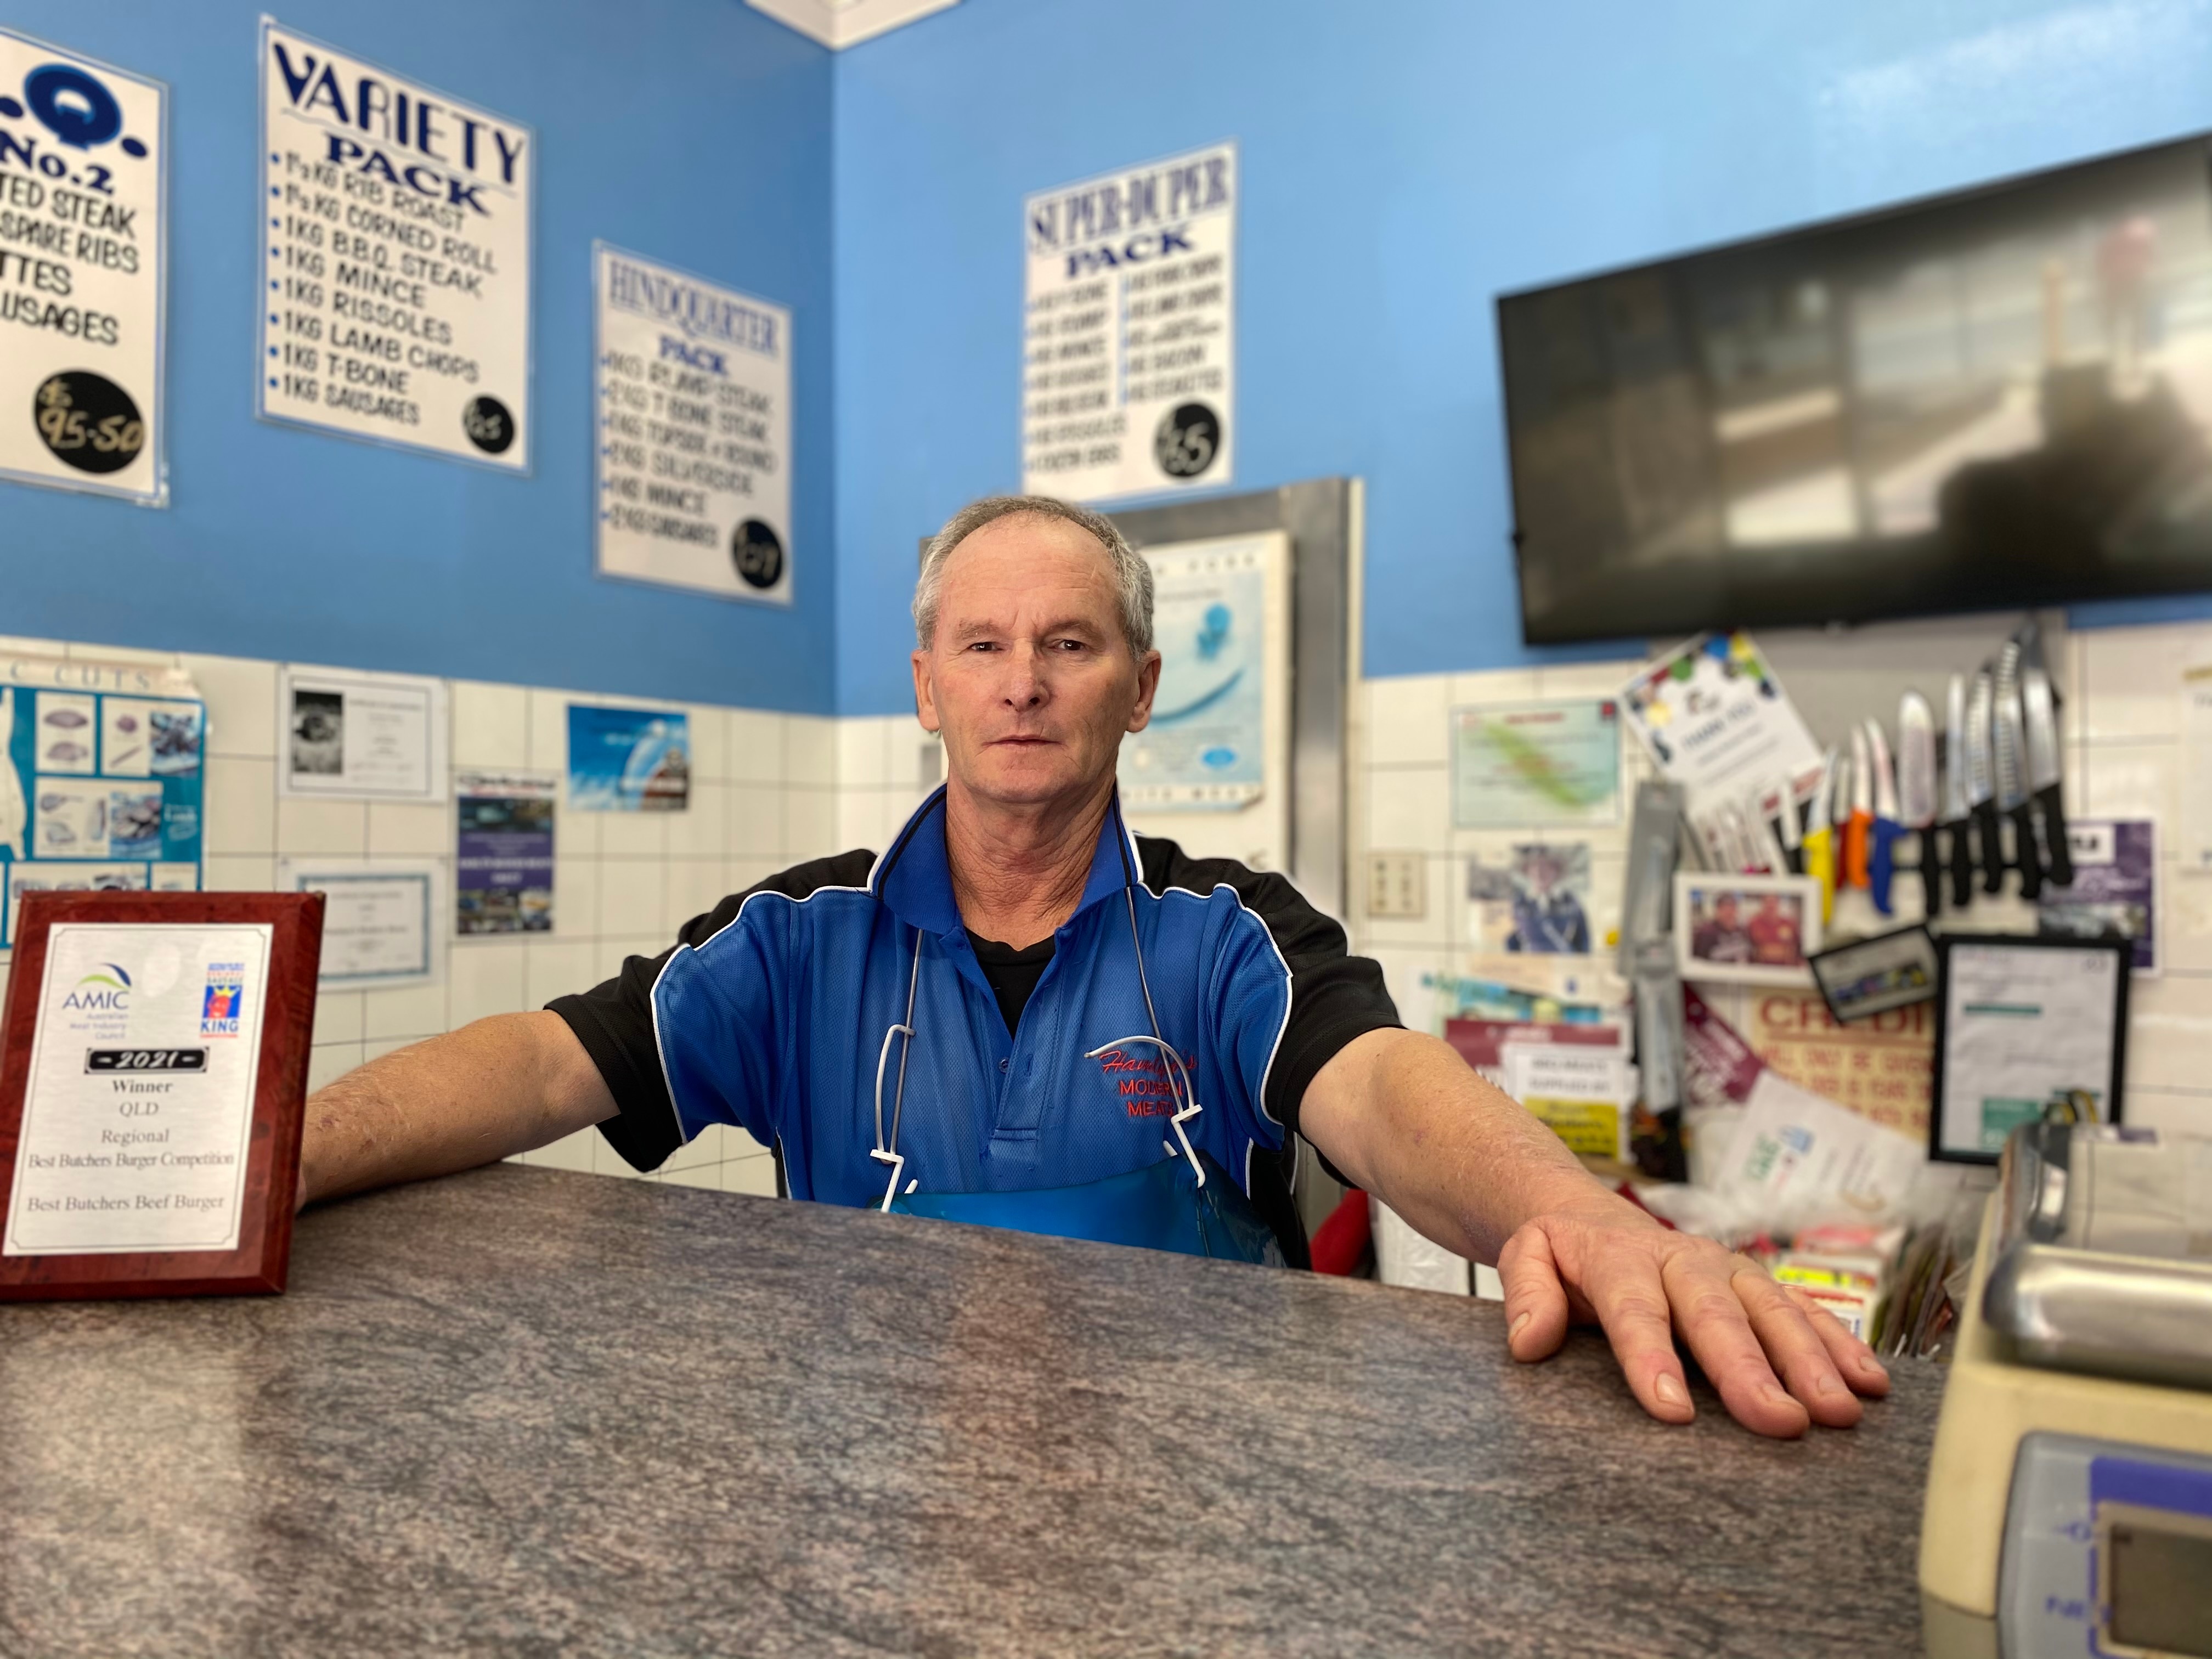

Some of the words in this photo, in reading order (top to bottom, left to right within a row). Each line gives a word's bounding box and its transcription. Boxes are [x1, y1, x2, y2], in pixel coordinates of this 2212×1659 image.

[273, 42, 525, 184] VARIETY
[324, 129, 491, 217] PACK
[53, 187, 136, 240] STEAK
[344, 172, 385, 205] RIB
[393, 190, 464, 232] ROAST
[1, 212, 71, 258] SPARE
[77, 231, 140, 275] RIBS
[286, 216, 323, 247] 1KG
[401, 254, 483, 300] STEAK
[347, 205, 436, 251] CORNED
[442, 236, 497, 274] ROLL
[1065, 228, 1193, 278] PACK
[286, 246, 324, 276] 1KG
[336, 262, 426, 308] MINCE
[2, 291, 120, 347] USAGES
[286, 278, 324, 308] 1KG
[333, 290, 452, 346] RISSOLES
[285, 311, 322, 340] 1KG
[330, 324, 401, 362] LAMB
[408, 346, 479, 384] CHOPS
[285, 343, 318, 373] 1KG
[326, 353, 410, 394] T-BONE
[658, 335, 727, 375] PACK
[285, 375, 318, 403] 1KG
[326, 383, 420, 426] SAUSAGES
[55, 665, 150, 690] CUTS
[62, 991, 128, 1010] AMIC
[200, 1020, 239, 1033] KING
[112, 1080, 173, 1094] Winner
[119, 1102, 159, 1118] QLD
[1127, 1100, 1174, 1117] MEATS
[28, 1154, 55, 1169] Best
[59, 1154, 111, 1167] Butchers
[116, 1153, 157, 1170] Burger
[161, 1152, 234, 1169] Competition
[101, 1129, 170, 1147] Regional
[27, 1198, 60, 1212] Best
[65, 1196, 129, 1211] Butchers
[135, 1195, 171, 1209] Beef
[174, 1194, 225, 1212] Burger
